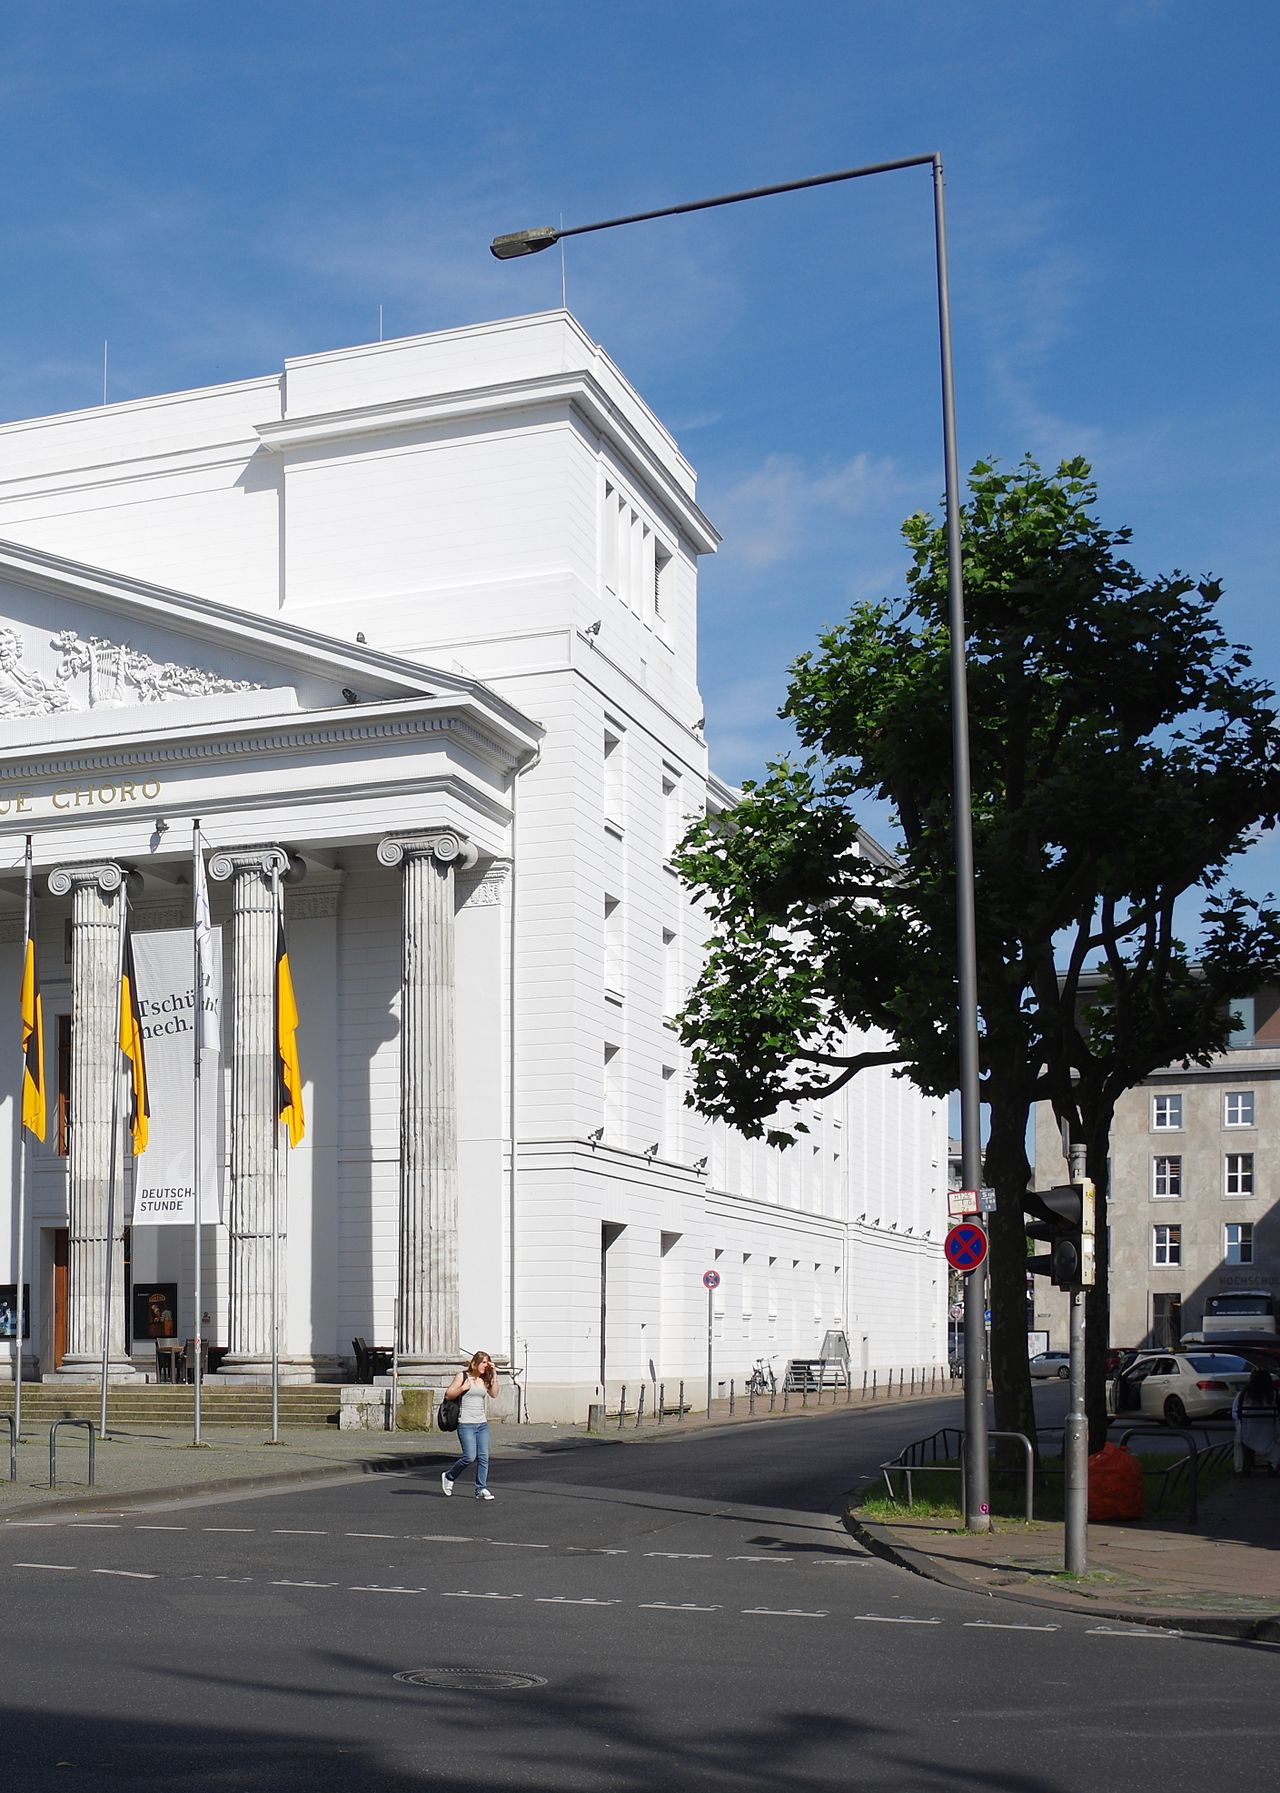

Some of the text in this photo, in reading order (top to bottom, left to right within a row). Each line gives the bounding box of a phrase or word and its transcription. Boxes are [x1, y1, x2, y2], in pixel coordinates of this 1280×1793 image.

[52, 777, 161, 809] CHORO
[141, 1187, 196, 1199] DEUTSCH-
[140, 1200, 184, 1212] STUNDE
